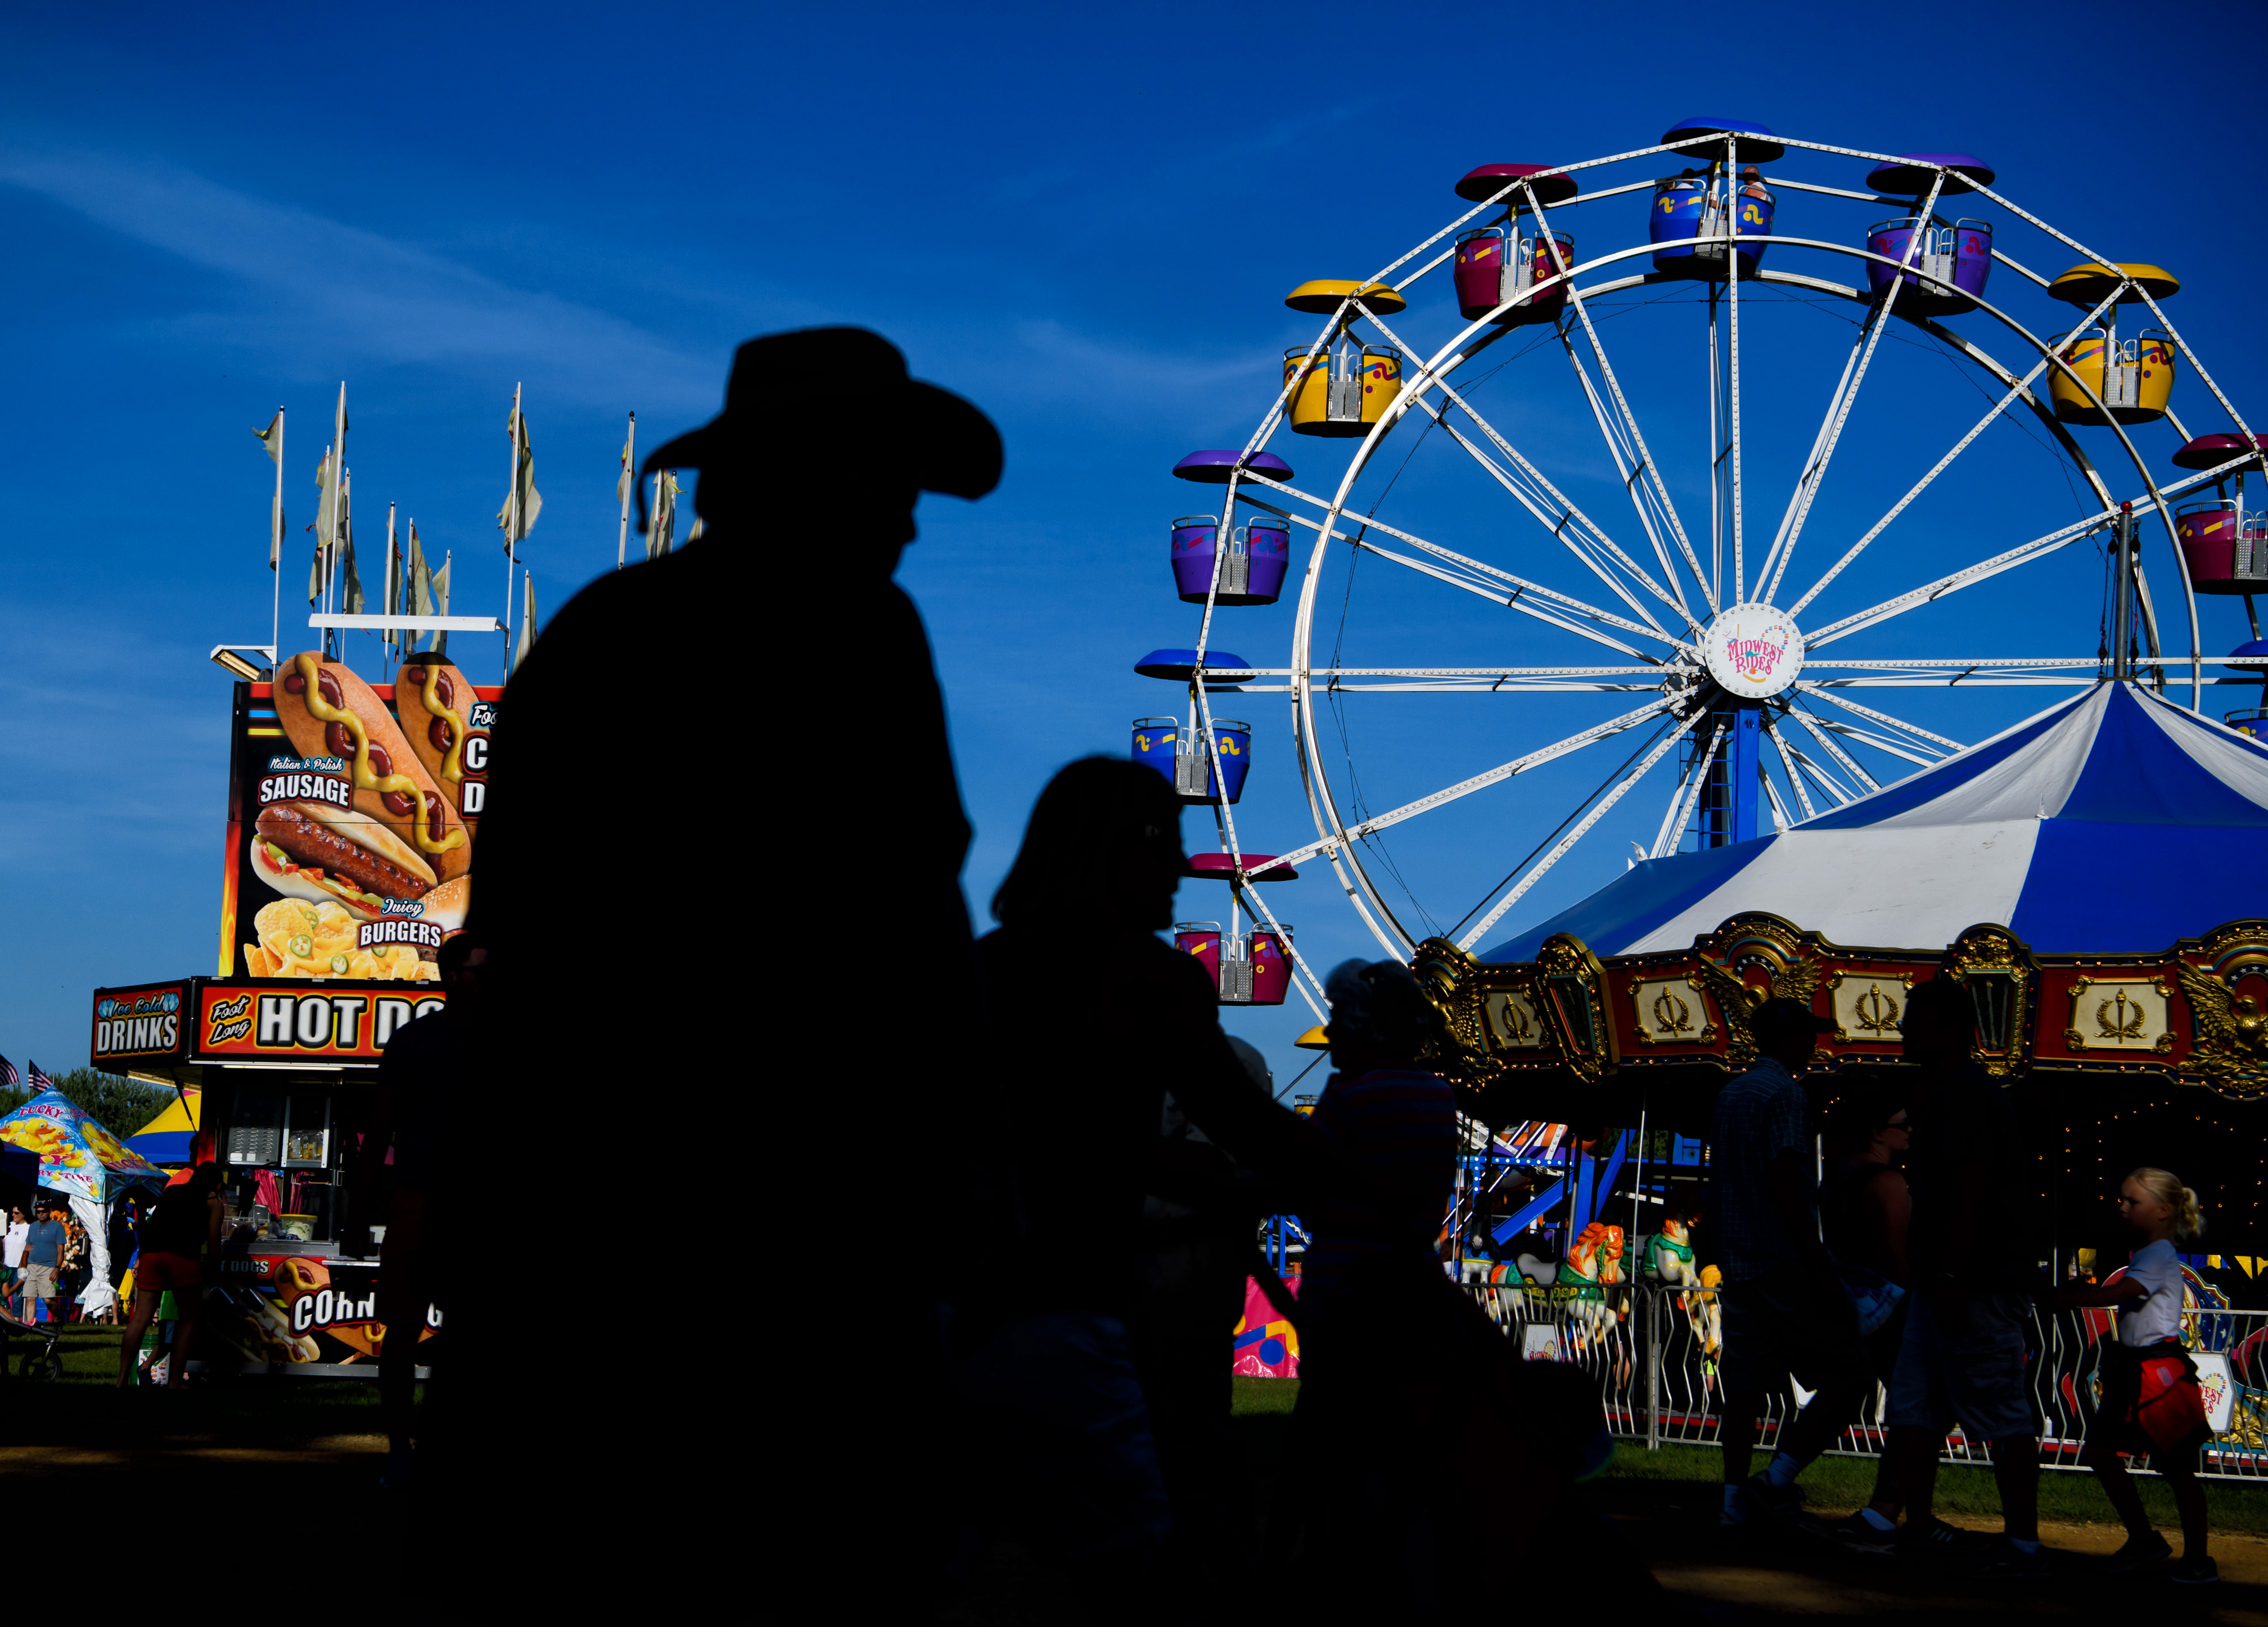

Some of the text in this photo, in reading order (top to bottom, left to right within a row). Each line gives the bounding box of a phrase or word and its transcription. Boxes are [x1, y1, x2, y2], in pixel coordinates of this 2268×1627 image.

[1727, 639, 1784, 665] MIDWEST
[1735, 655, 1773, 675] RIDES
[270, 756, 344, 770] Italian & Polish
[260, 774, 350, 806] SAUSAGE
[382, 898, 423, 917] Juicy
[360, 921, 441, 947] BURGERS
[112, 994, 165, 1016] Ice Cold
[213, 997, 249, 1021] Foot
[96, 1015, 178, 1052] DRINKS
[211, 1020, 250, 1043] Long
[260, 998, 365, 1046] HOT
[19, 1105, 64, 1118] LUCKY
[231, 1260, 269, 1273] DOGS
